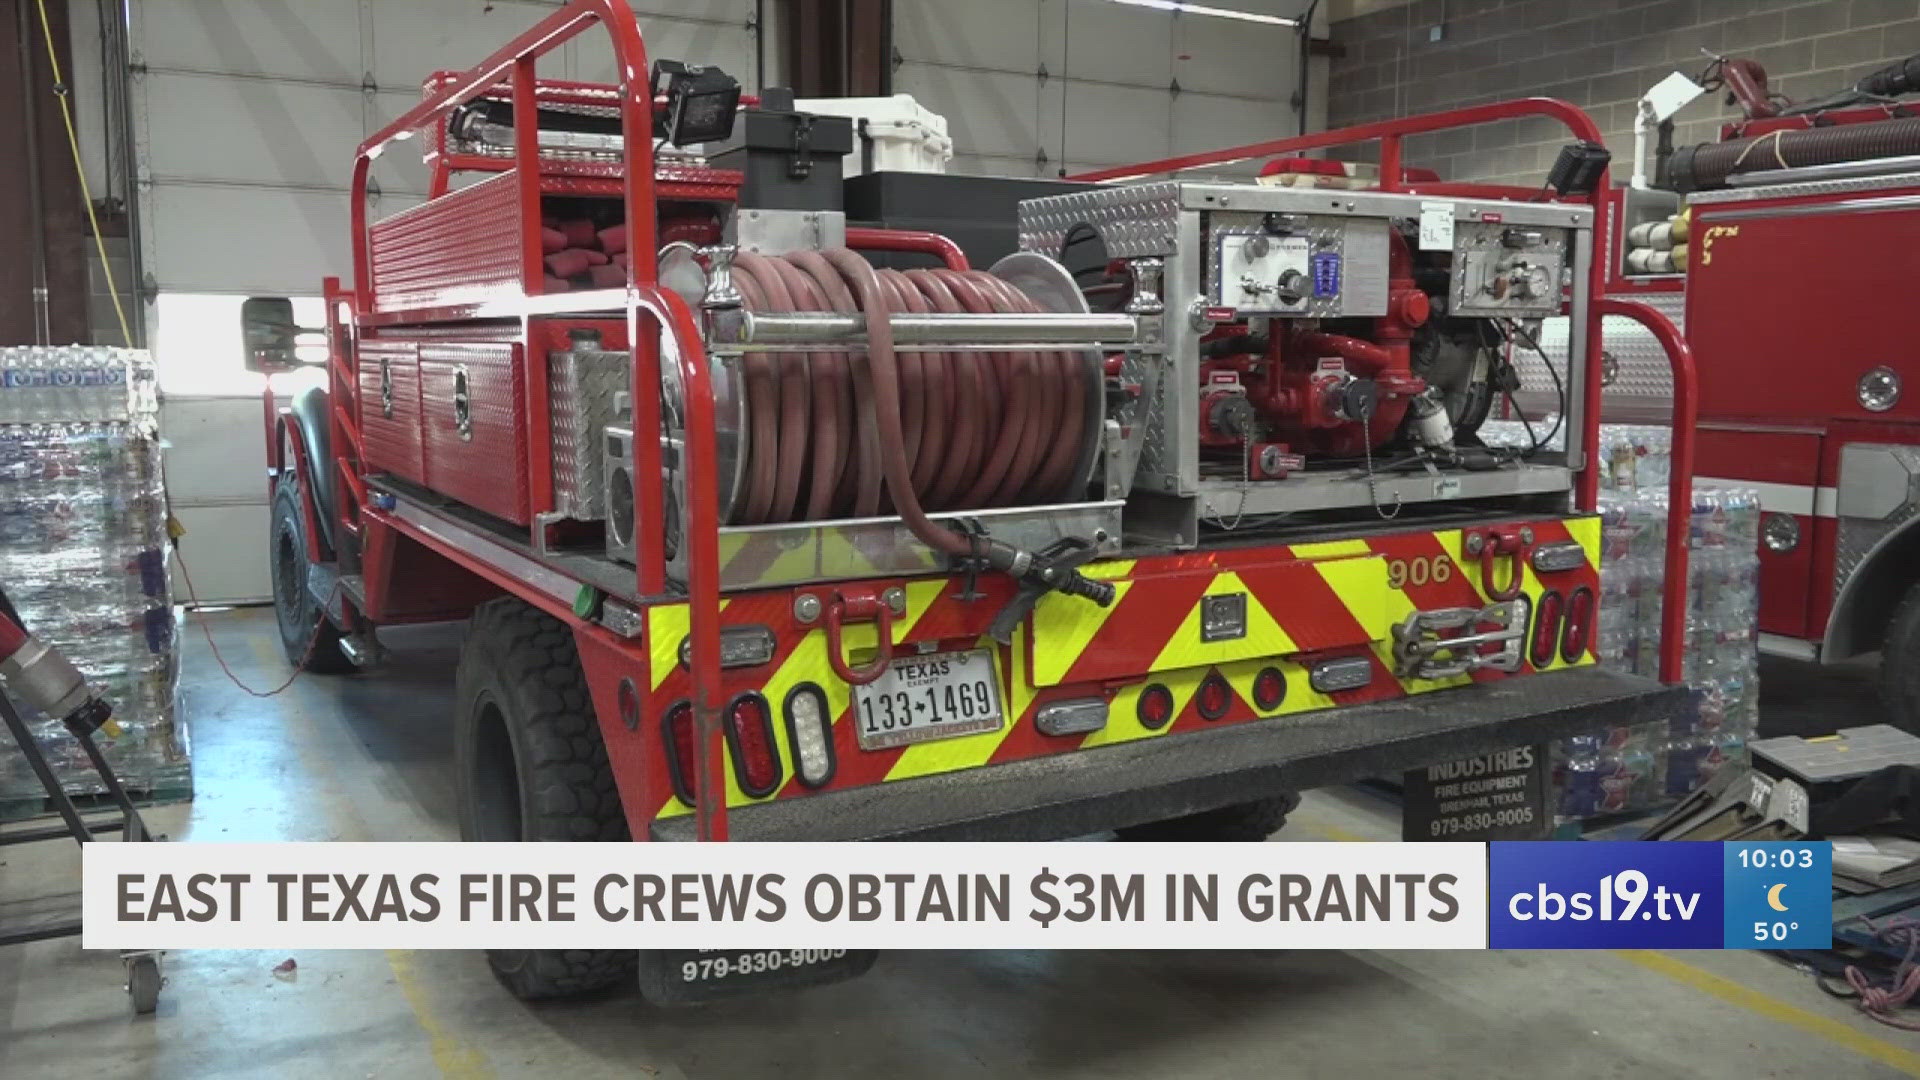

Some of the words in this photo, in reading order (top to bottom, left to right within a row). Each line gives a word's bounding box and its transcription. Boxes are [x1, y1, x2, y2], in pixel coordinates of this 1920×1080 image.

[1387, 554, 1450, 590] 906
[894, 661, 951, 681] TEXAS
[907, 678, 939, 688] EXEMPT
[1428, 745, 1534, 781] INDUSTRIES
[1434, 784, 1460, 799] FIRE
[1462, 775, 1528, 795] EQUIPMENT
[1492, 791, 1525, 806] TEXAS
[1430, 807, 1534, 837] 979-830-9005
